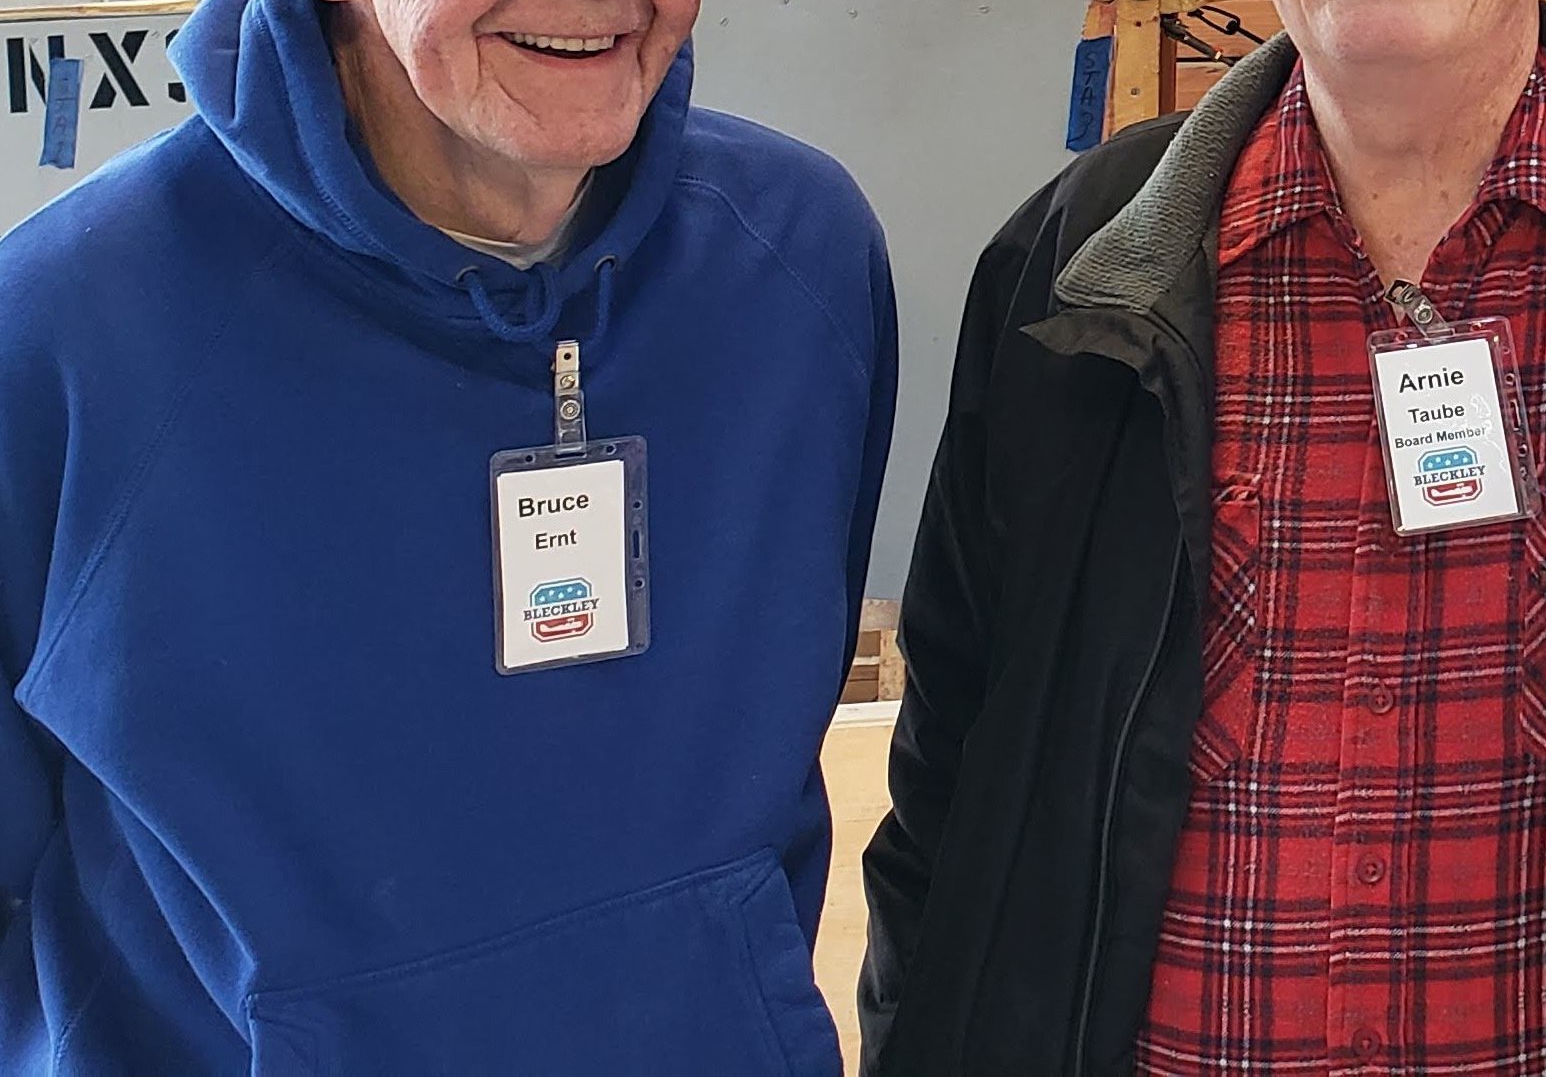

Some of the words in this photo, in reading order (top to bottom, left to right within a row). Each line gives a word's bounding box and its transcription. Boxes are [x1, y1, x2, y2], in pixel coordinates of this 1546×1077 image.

[7, 29, 186, 114] NX
[1398, 367, 1465, 394] Arnie
[1408, 403, 1466, 424] Taube
[1394, 431, 1433, 450] Board
[1436, 426, 1488, 444] Member
[1413, 465, 1487, 487] BLECKLEY
[518, 493, 590, 518] Bruce
[535, 528, 577, 550] Ernt
[523, 598, 600, 622] BLECKLEY
